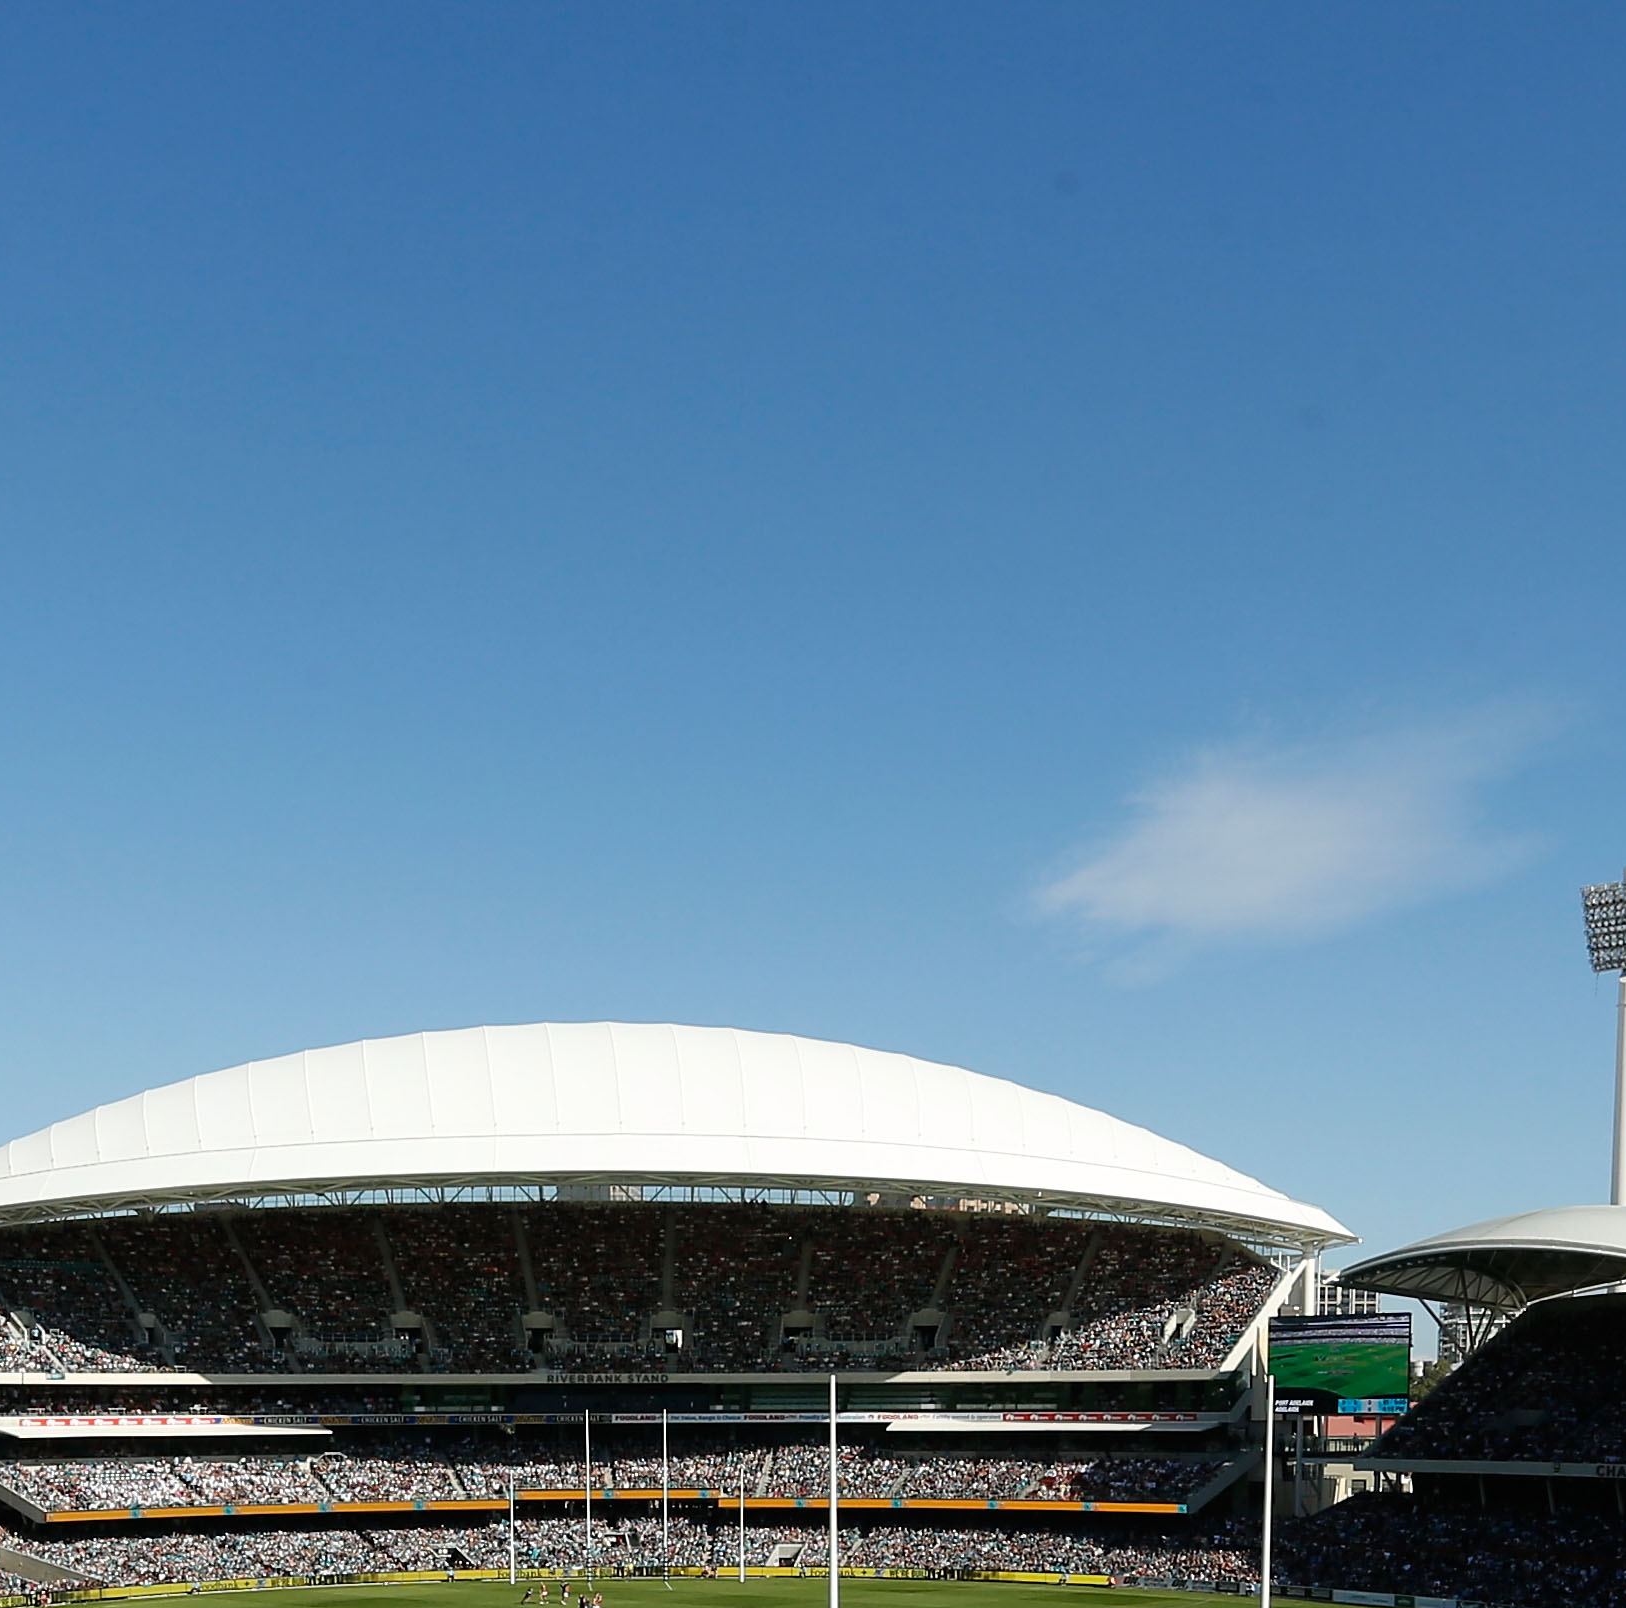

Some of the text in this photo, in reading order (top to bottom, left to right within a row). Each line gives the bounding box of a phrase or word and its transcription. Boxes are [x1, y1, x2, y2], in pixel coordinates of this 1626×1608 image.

[547, 1374, 669, 1383] RIVERBANK STAND
[263, 1416, 291, 1424] CHICKEN
[292, 1416, 307, 1424] SALT
[360, 1416, 389, 1424] CHICKEN
[390, 1416, 404, 1424] SALT
[458, 1415, 486, 1423] CHICKEN
[487, 1415, 502, 1423] SALT
